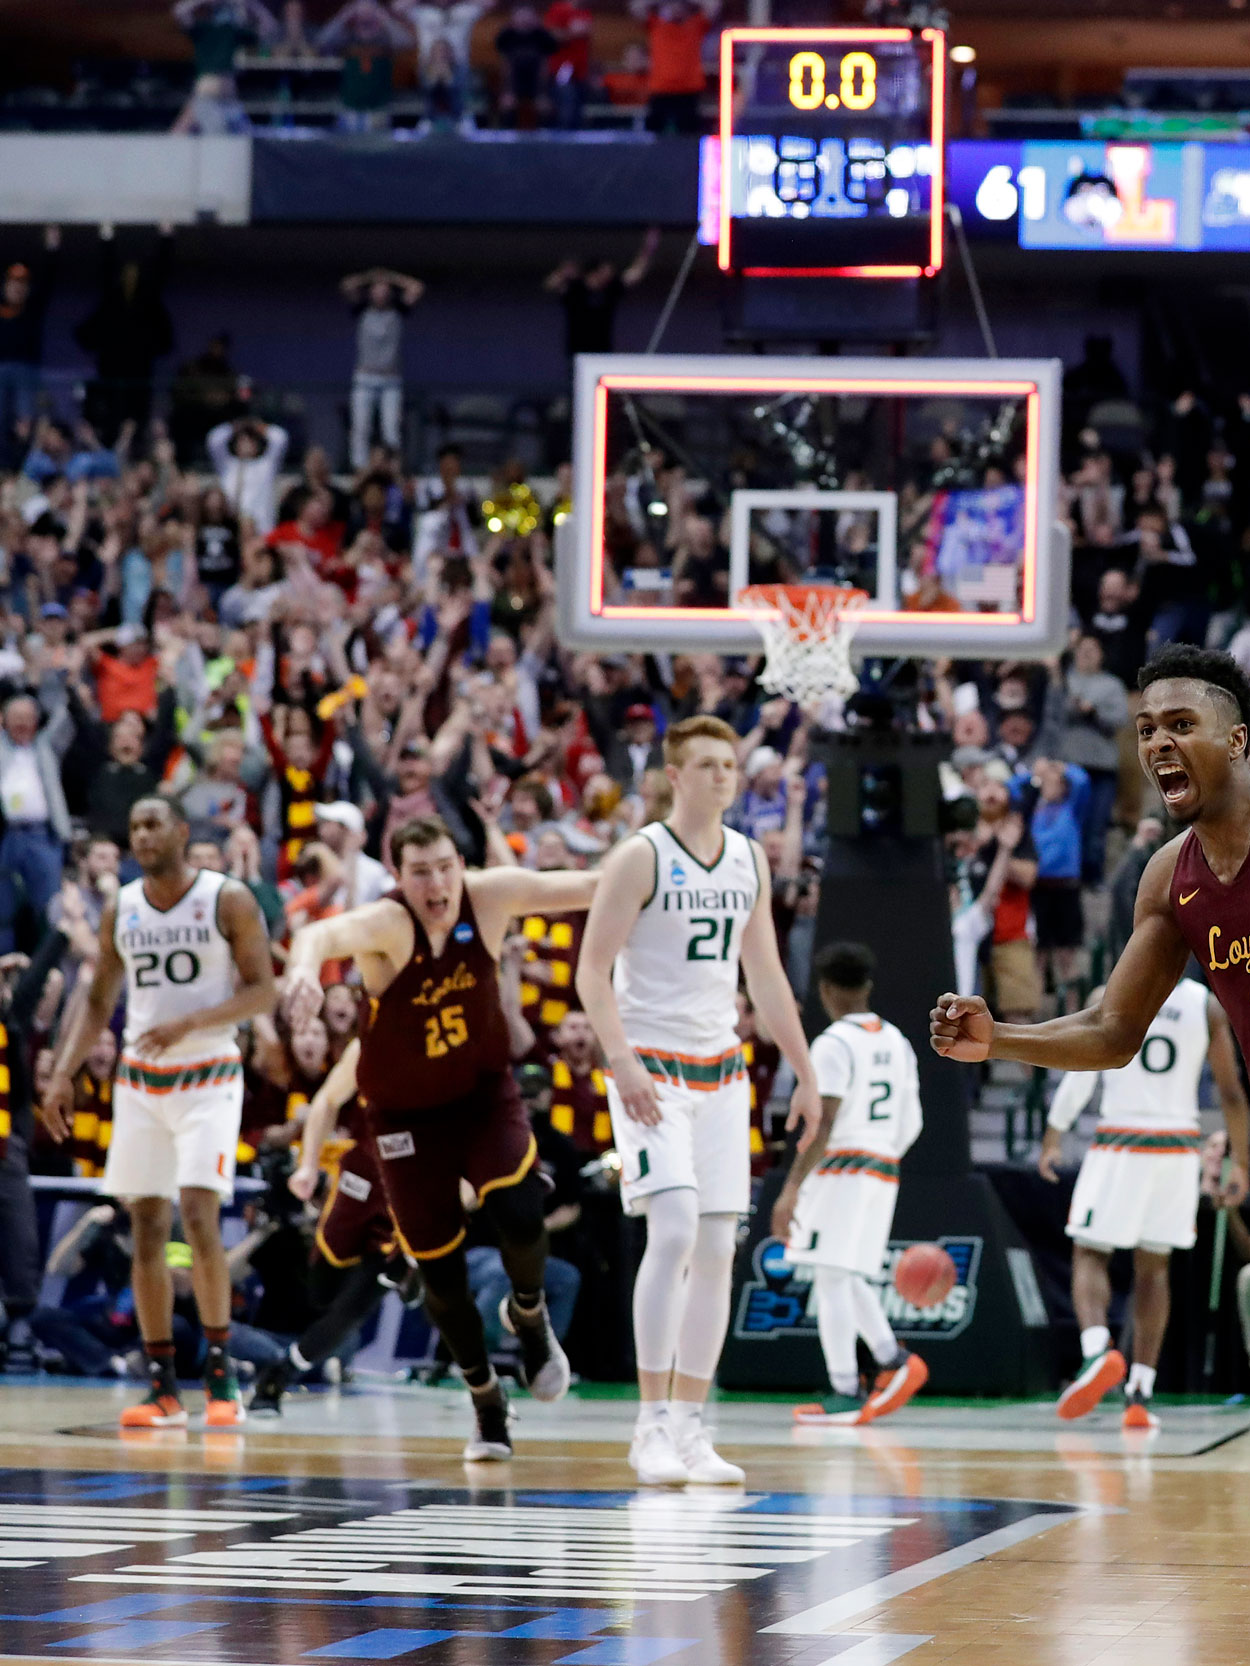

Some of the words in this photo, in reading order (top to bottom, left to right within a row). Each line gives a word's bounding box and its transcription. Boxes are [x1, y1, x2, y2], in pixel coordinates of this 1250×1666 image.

[789, 52, 876, 110] 0.0
[975, 166, 1046, 221] 61
[686, 917, 734, 961] 21
[132, 949, 201, 988] 20
[425, 1003, 469, 1059] 25
[869, 1080, 892, 1122] 2
